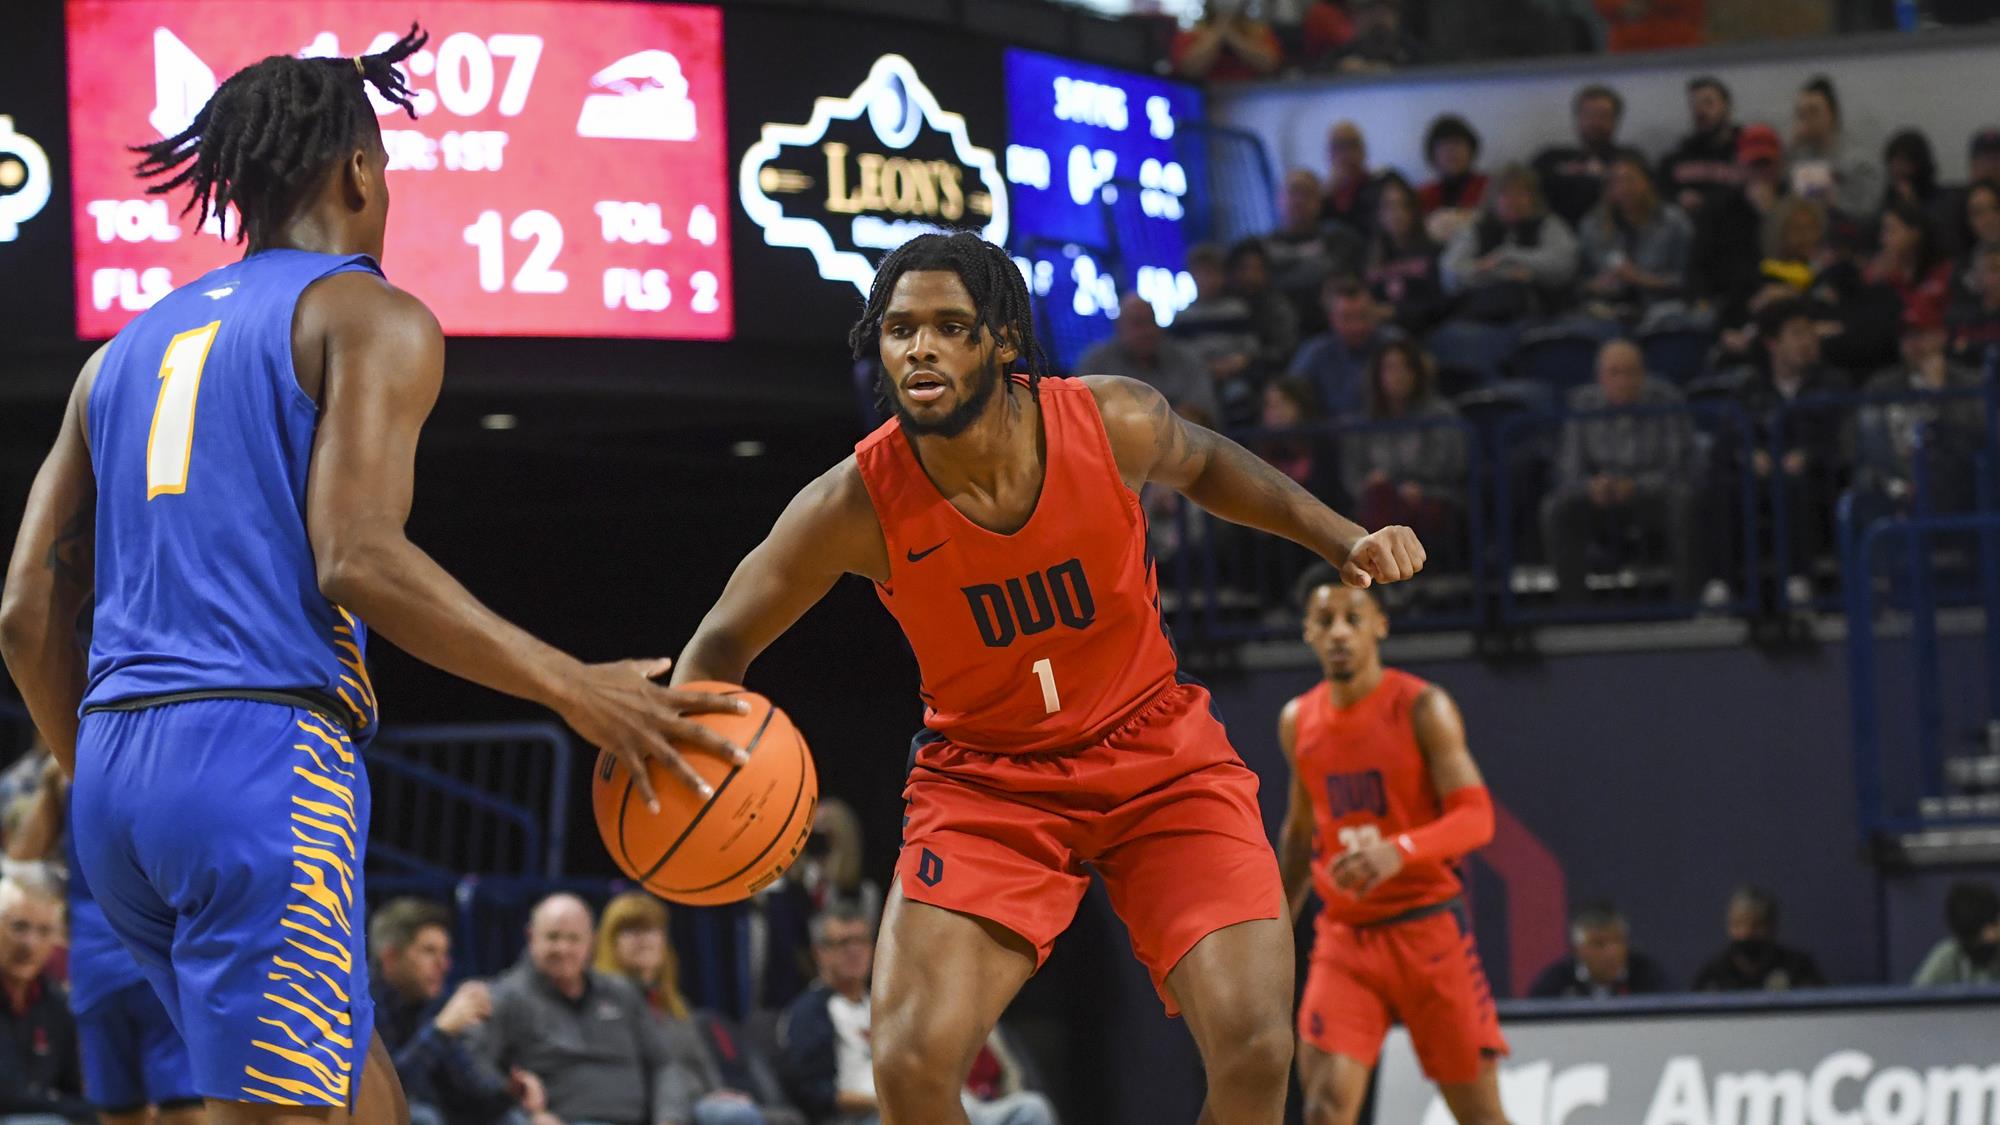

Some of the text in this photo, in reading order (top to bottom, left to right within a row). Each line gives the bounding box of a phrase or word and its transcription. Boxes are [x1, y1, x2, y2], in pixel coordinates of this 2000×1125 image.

[87, 199, 181, 243] TOL
[594, 200, 672, 244] TOL
[463, 209, 568, 293] 12
[603, 267, 720, 314] FLS 2
[147, 320, 222, 501] 1
[960, 558, 1097, 648] DUQ
[1032, 658, 1061, 714] 1
